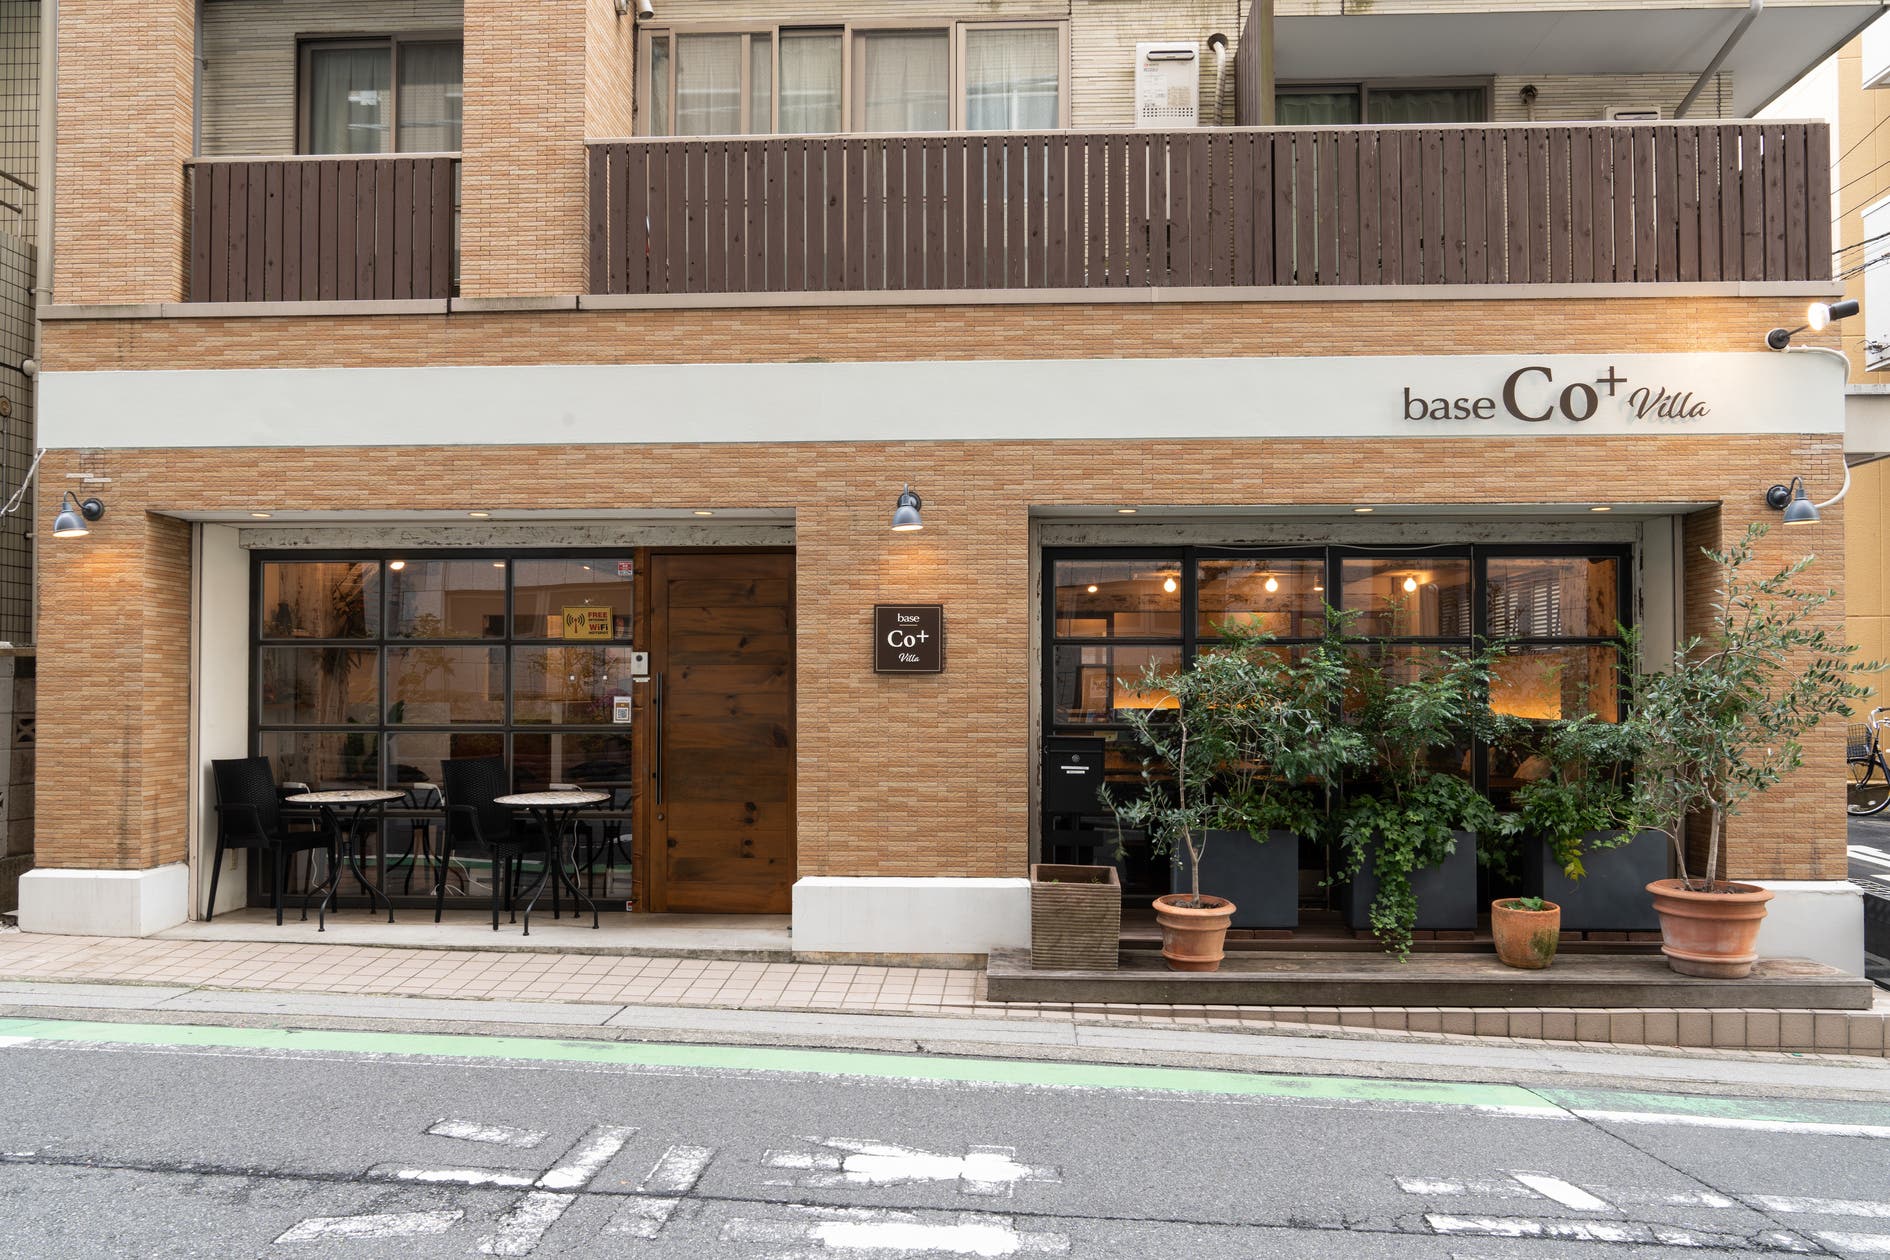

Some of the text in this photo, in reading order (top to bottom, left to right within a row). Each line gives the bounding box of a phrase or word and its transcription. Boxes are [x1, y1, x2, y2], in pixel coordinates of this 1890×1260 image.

[1404, 366, 1711, 422] base Co+ Villa
[897, 613, 920, 622] base
[589, 623, 608, 631] WiFi
[887, 629, 929, 647] Co+
[898, 652, 920, 662] Villa
